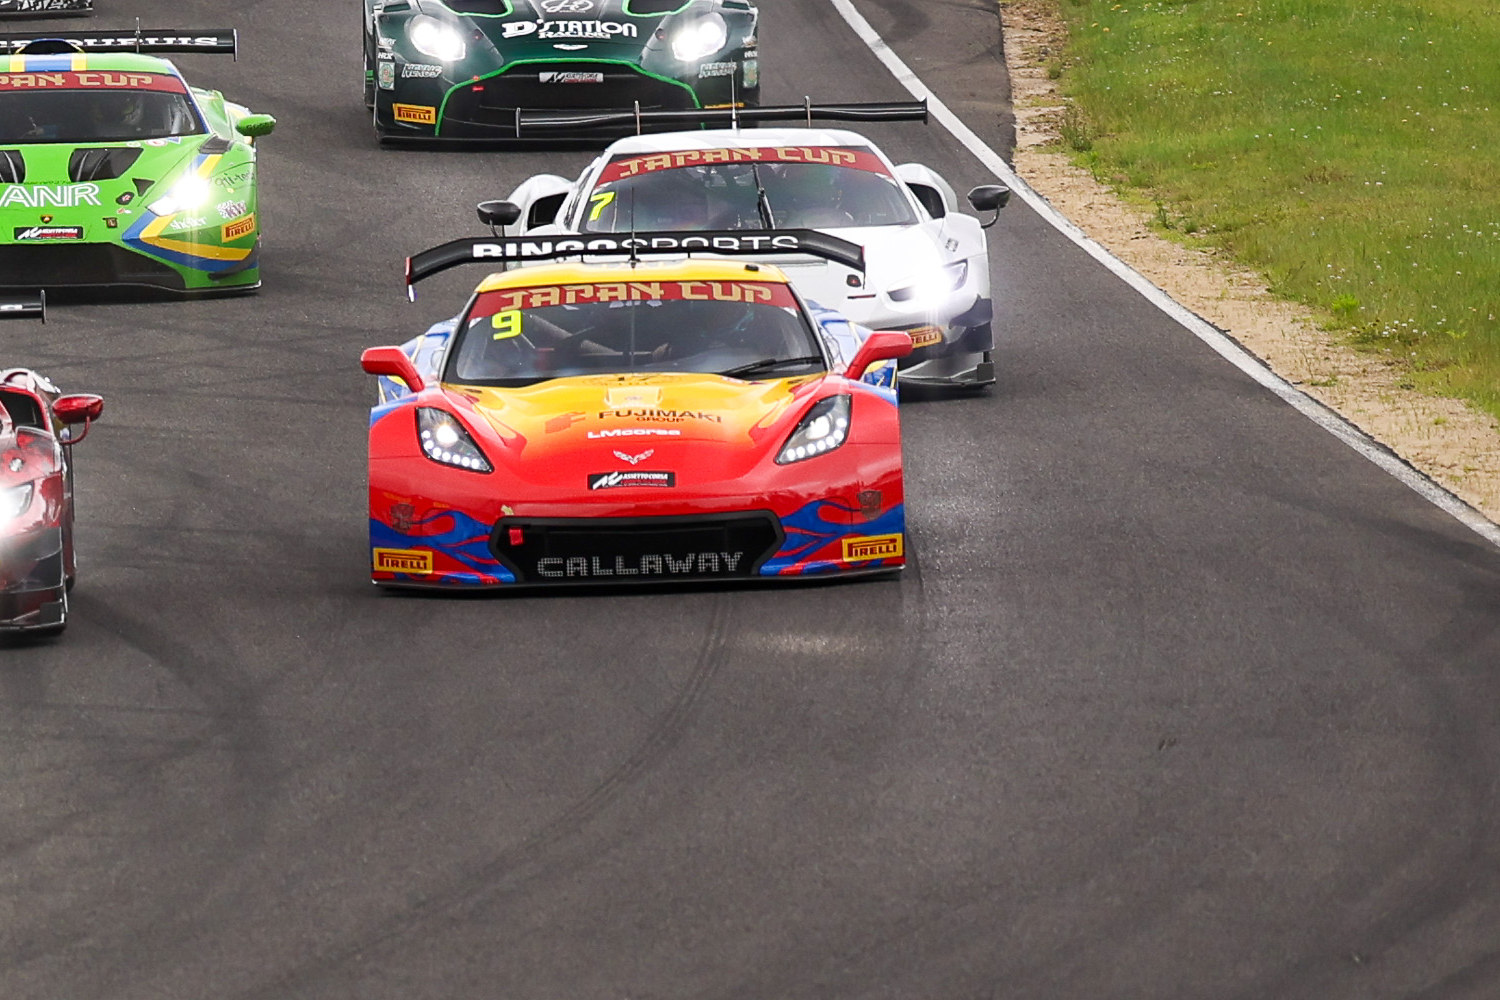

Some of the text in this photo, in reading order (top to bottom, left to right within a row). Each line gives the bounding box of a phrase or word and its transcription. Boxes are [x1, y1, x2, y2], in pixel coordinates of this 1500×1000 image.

[75, 74, 153, 87] CUP
[397, 106, 432, 121] PIRELLI
[617, 148, 856, 177] JAPAN CUP
[589, 191, 615, 221] 7
[225, 217, 253, 238] PIRELLI
[500, 281, 772, 312] JAPAN CUP
[492, 309, 522, 340] 9
[598, 409, 722, 423] FUJIMAKI
[847, 538, 897, 557] PIRELLI
[378, 552, 428, 570] PIRELLI
[537, 552, 743, 577] CALLAWAY
